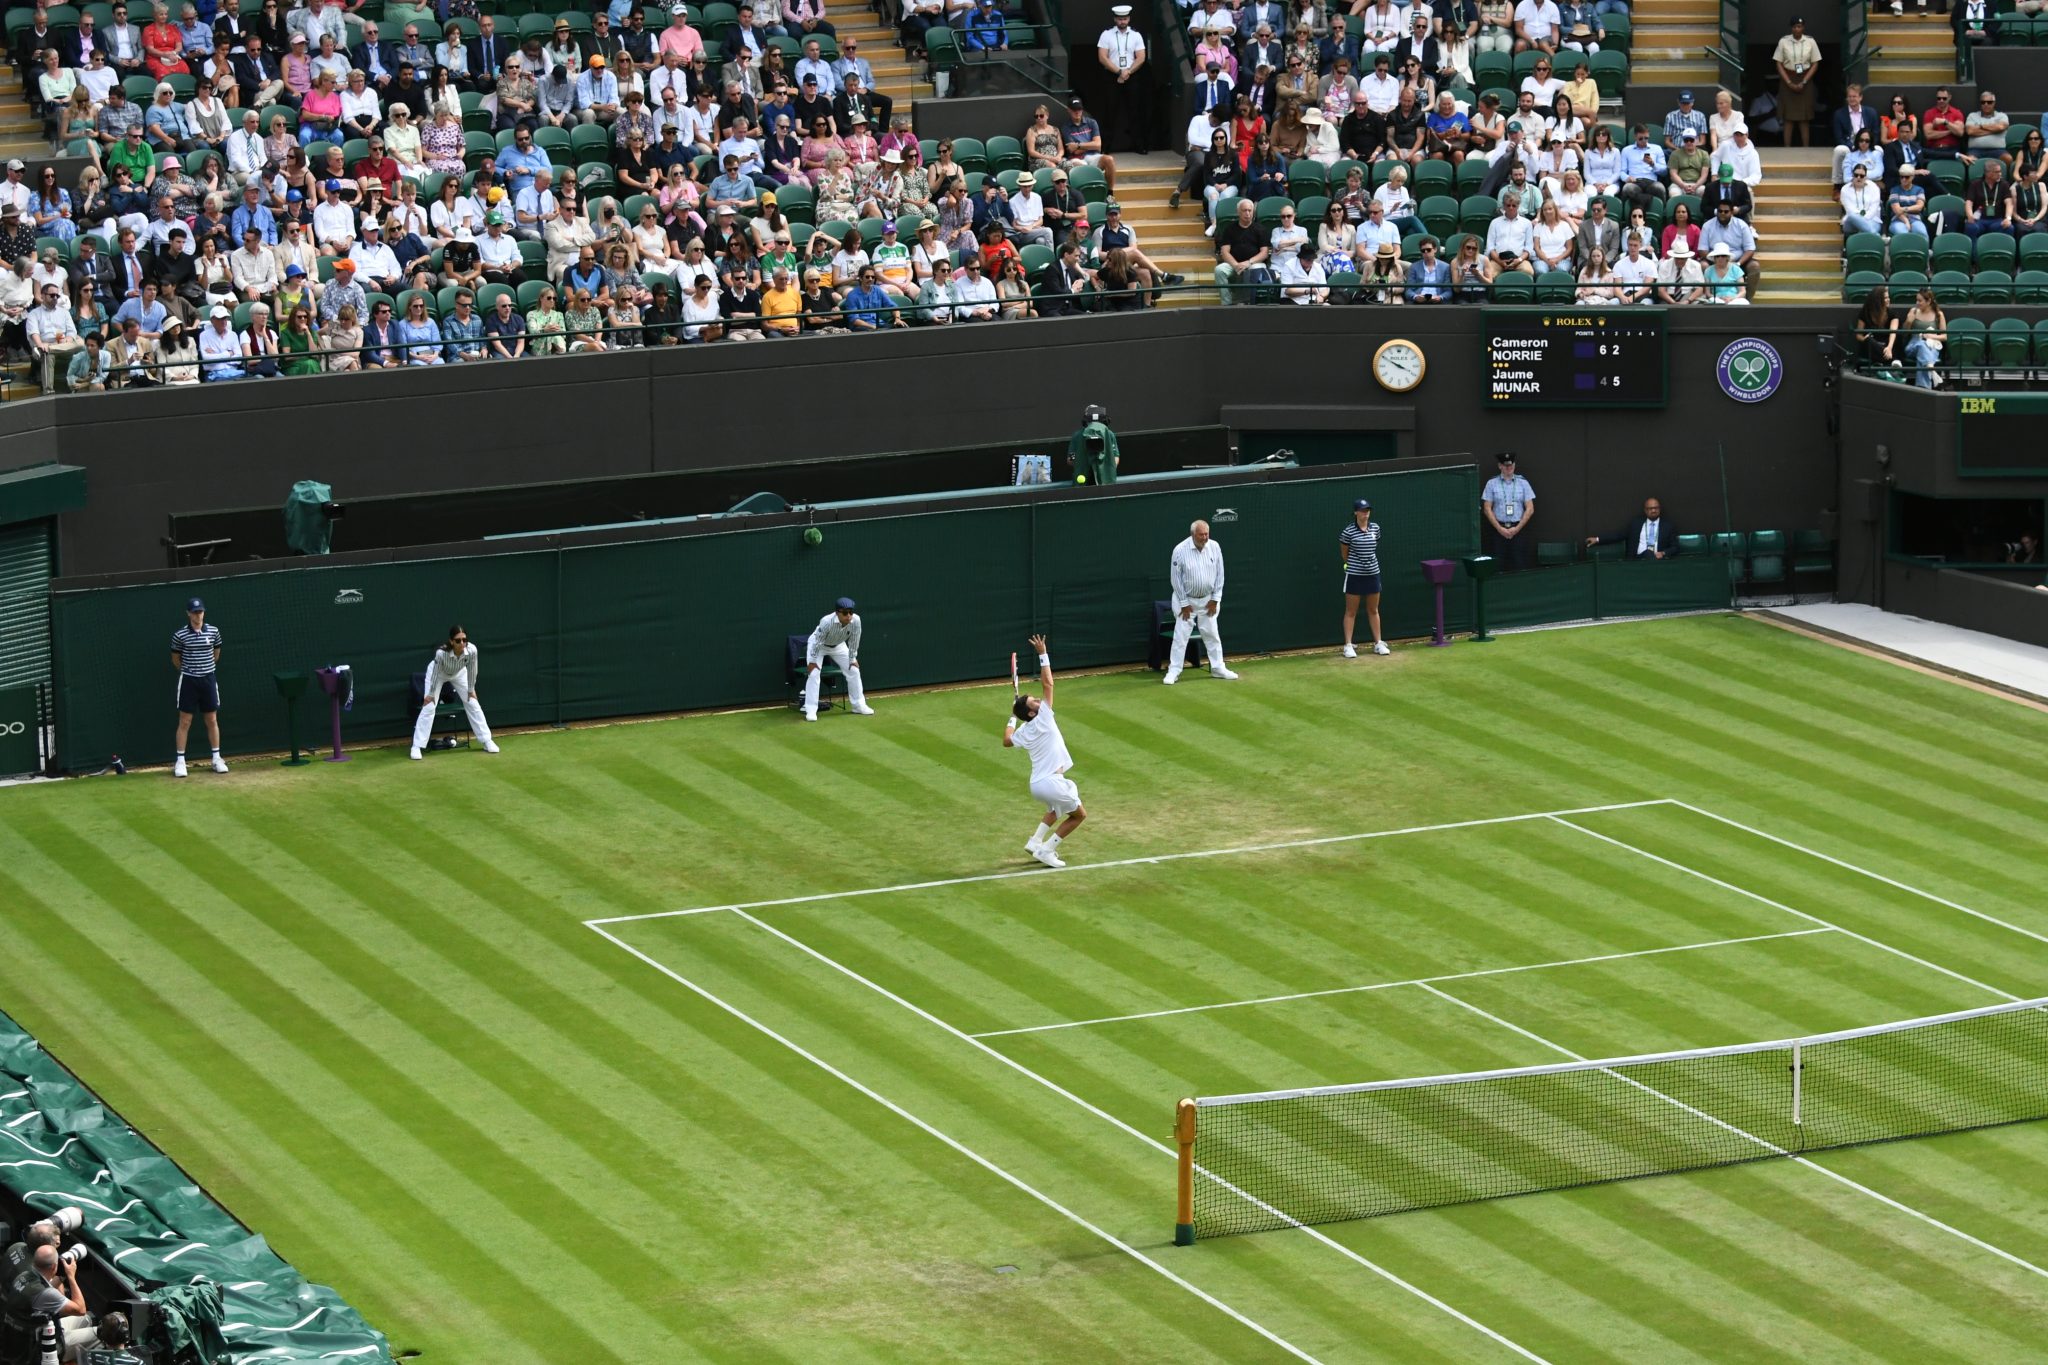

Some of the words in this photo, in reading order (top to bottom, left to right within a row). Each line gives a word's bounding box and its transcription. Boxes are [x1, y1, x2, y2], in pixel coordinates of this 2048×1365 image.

[1556, 318, 1592, 326] ROLEX
[1492, 337, 1548, 348] Cameron
[1492, 350, 1543, 361] NORRIE
[1599, 345, 1607, 355] 6
[1612, 345, 1620, 355] 2
[1720, 354, 1730, 368] THE
[1728, 342, 1778, 368] CHAMPIONSHIPS
[1492, 369, 1534, 380] Jaume
[1600, 376, 1608, 386] 4
[1612, 376, 1620, 386] 5
[1492, 382, 1540, 393] MUNAR
[1728, 385, 1772, 400] WIMBLEDON
[1961, 398, 1995, 413] IBM
